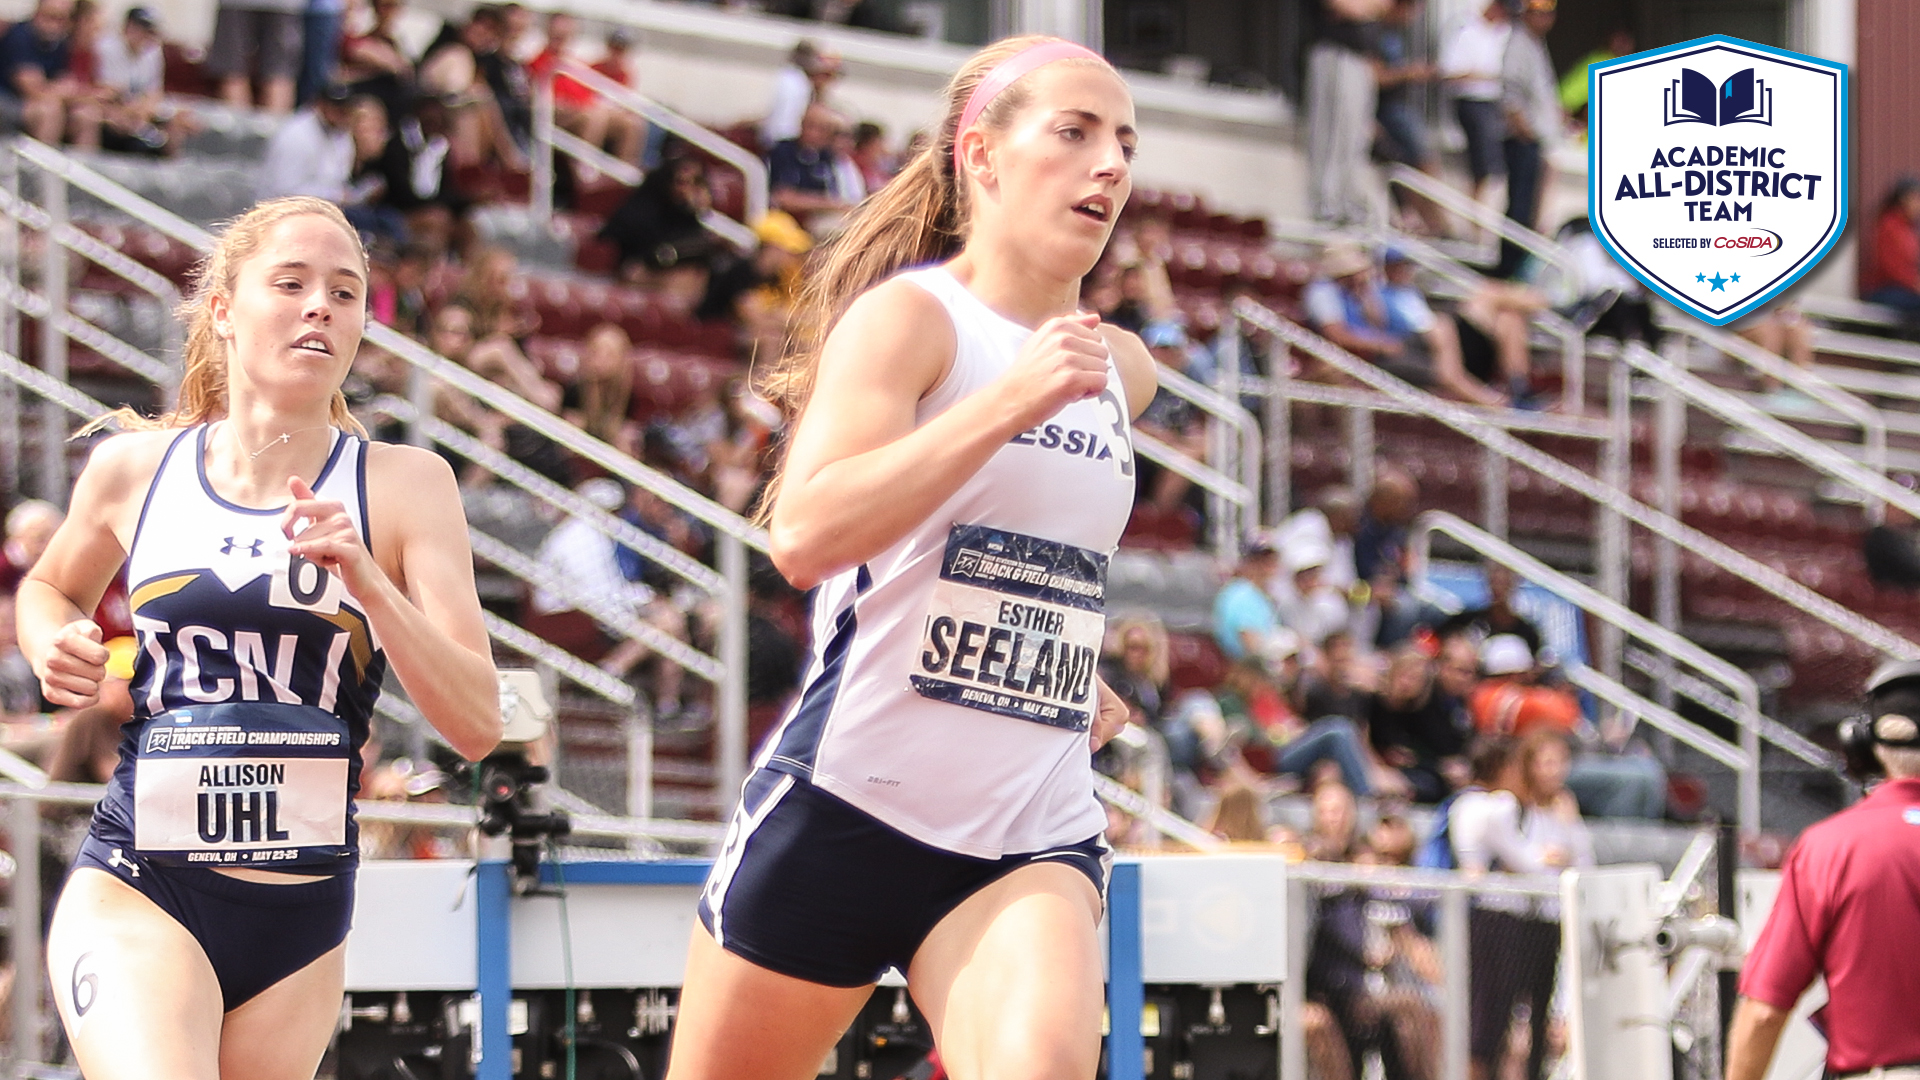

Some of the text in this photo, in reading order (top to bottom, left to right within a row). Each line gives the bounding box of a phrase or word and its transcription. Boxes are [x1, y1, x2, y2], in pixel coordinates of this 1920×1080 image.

[1099, 388, 1134, 477] 3
[289, 553, 329, 606] 6
[978, 560, 1012, 580] TRACK
[1020, 569, 1049, 587] FIELD
[998, 600, 1065, 636] ESTHER
[922, 616, 1096, 705] SEELAND
[996, 696, 1011, 708] OH
[1022, 701, 1042, 715] MAY
[171, 732, 207, 746] TRACK
[215, 732, 247, 746] FIELD
[247, 732, 341, 746] CHAMPIONSHIPS
[198, 764, 285, 787] ALLISON
[197, 791, 290, 844] UHL
[187, 849, 299, 863] GENEVA, OH MAY 23-25
[72, 950, 99, 1018] 6
